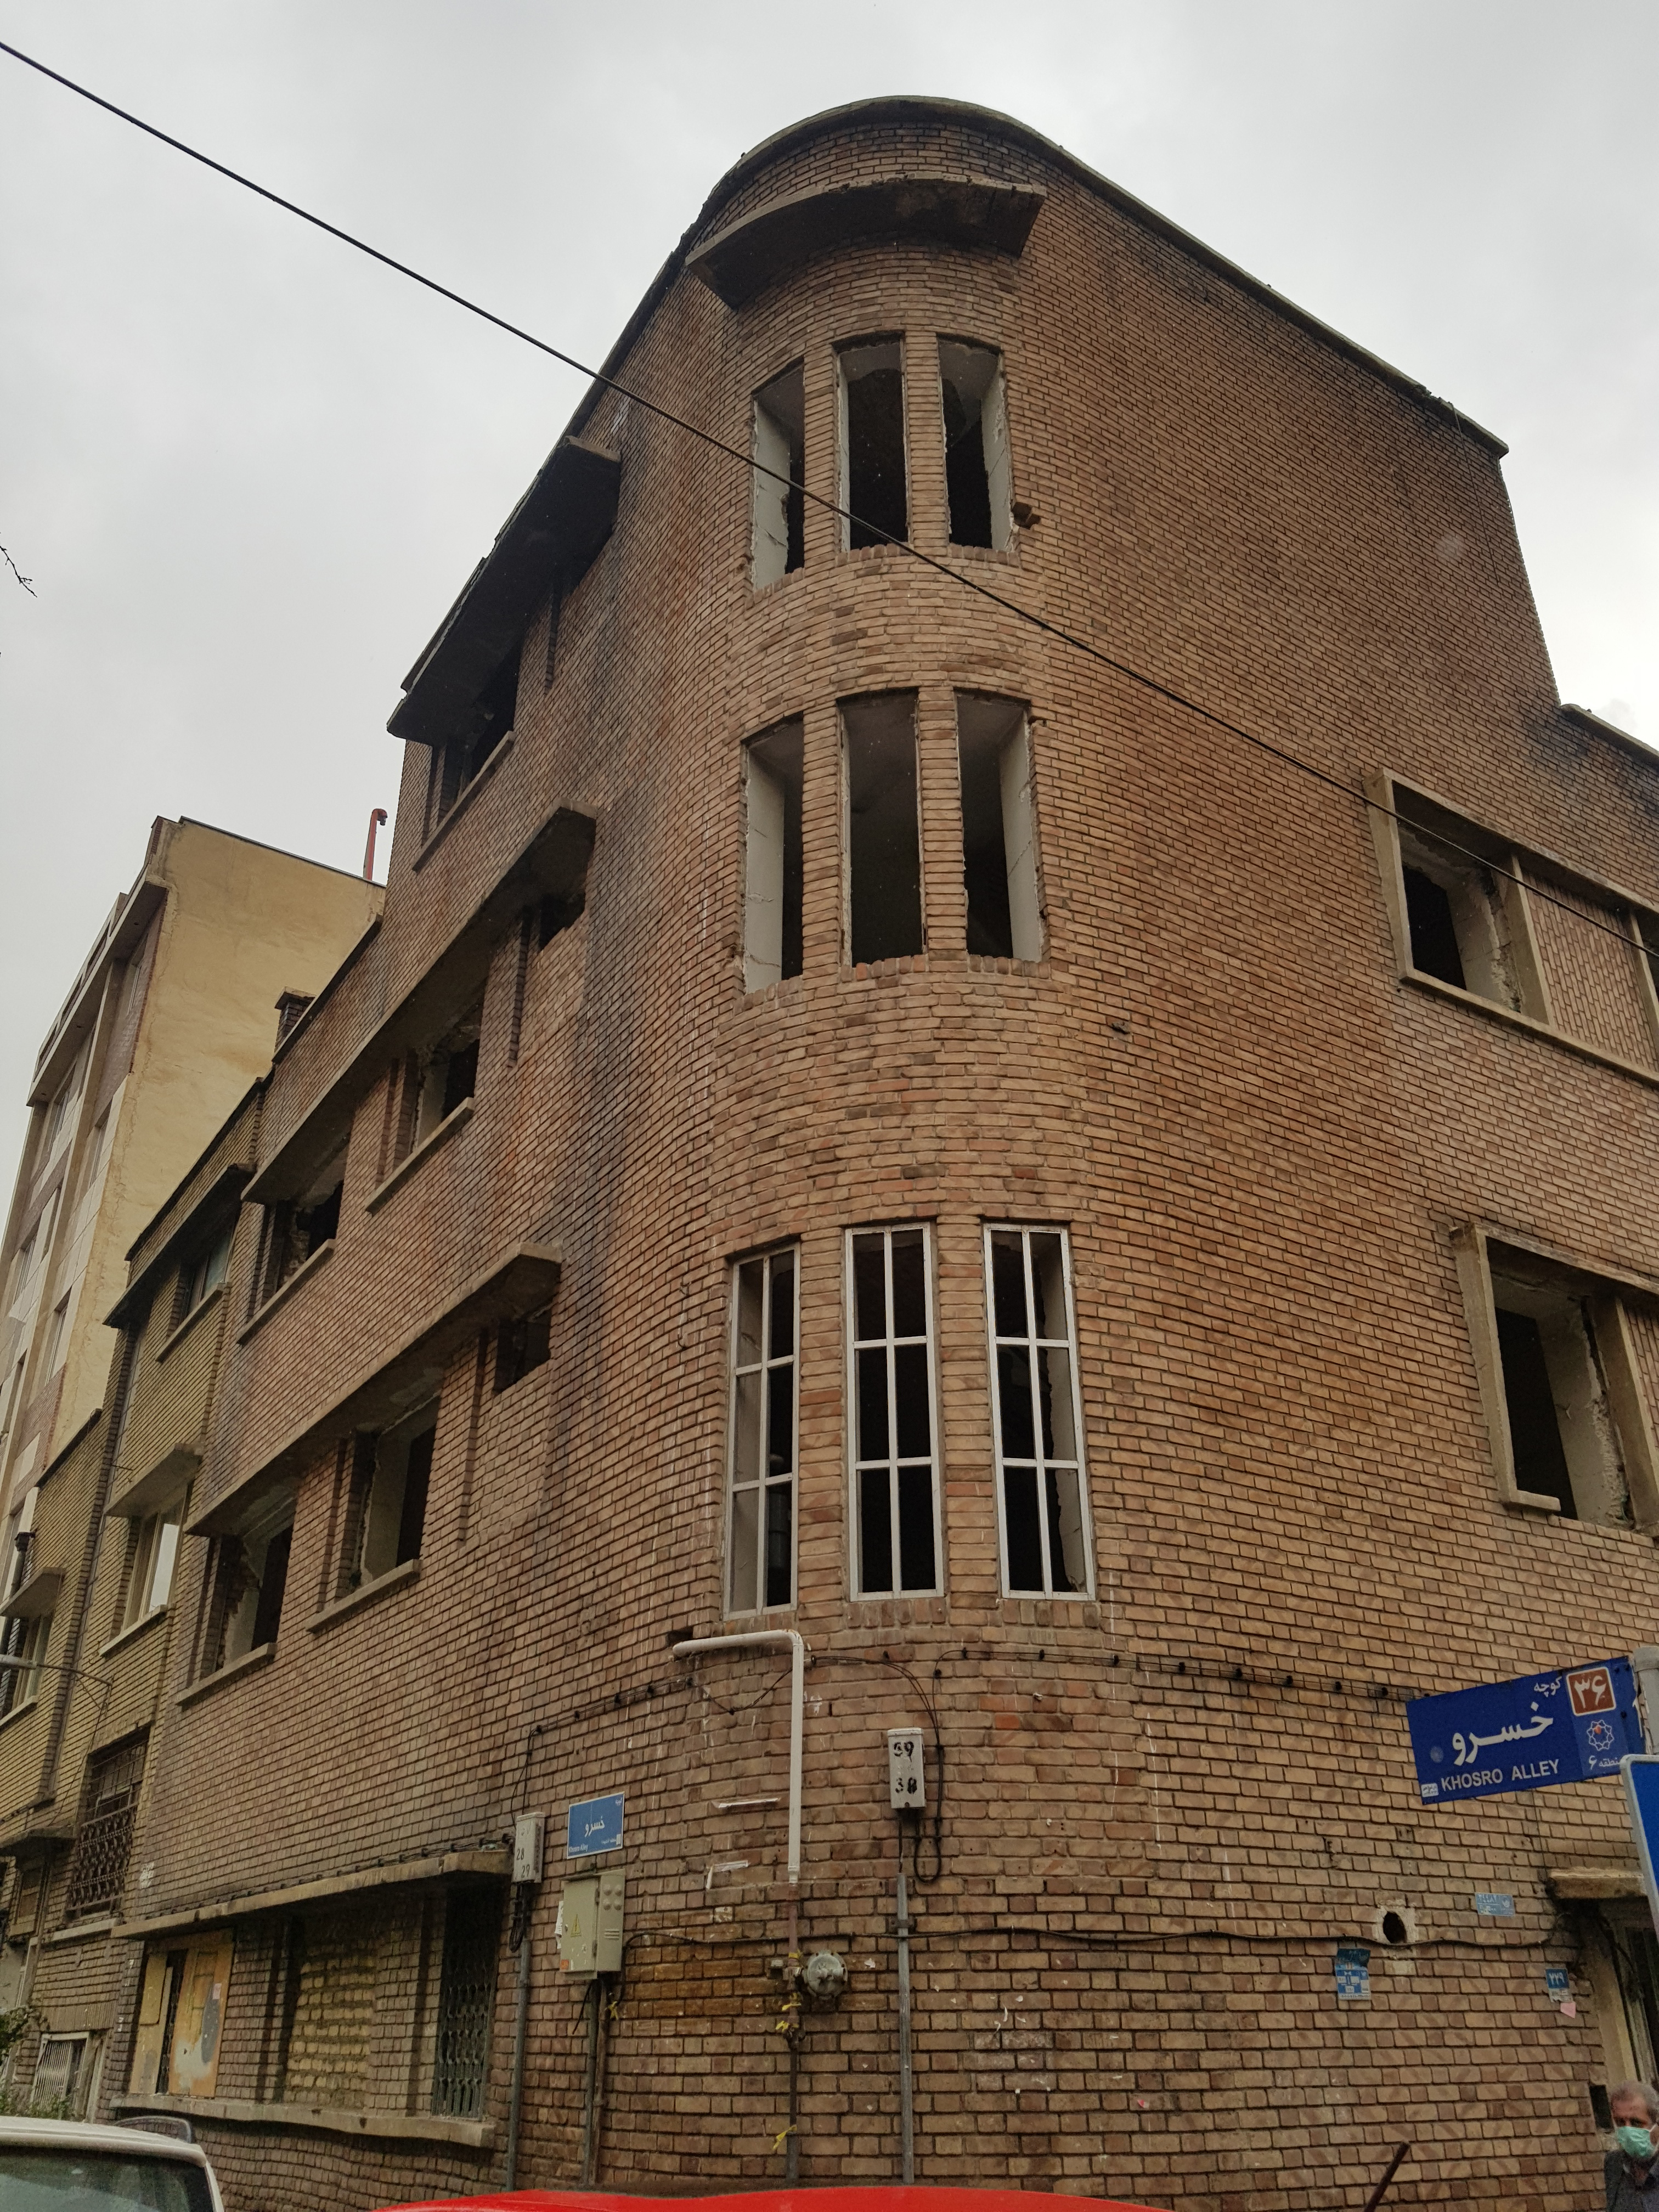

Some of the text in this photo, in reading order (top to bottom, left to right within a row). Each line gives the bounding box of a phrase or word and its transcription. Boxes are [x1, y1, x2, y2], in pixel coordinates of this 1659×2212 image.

[1534, 1676, 1562, 1697] کوچه
[1574, 1675, 1606, 1709] ۳۶
[1452, 1701, 1554, 1766] خسرو
[1599, 1757, 1622, 1767] نطقه
[1441, 1768, 1503, 1791] KHOSRO
[1511, 1759, 1559, 1781] ALLEY
[584, 1815, 605, 1838] خسرو
[516, 1848, 525, 1860] 28
[521, 1864, 530, 1878] 29
